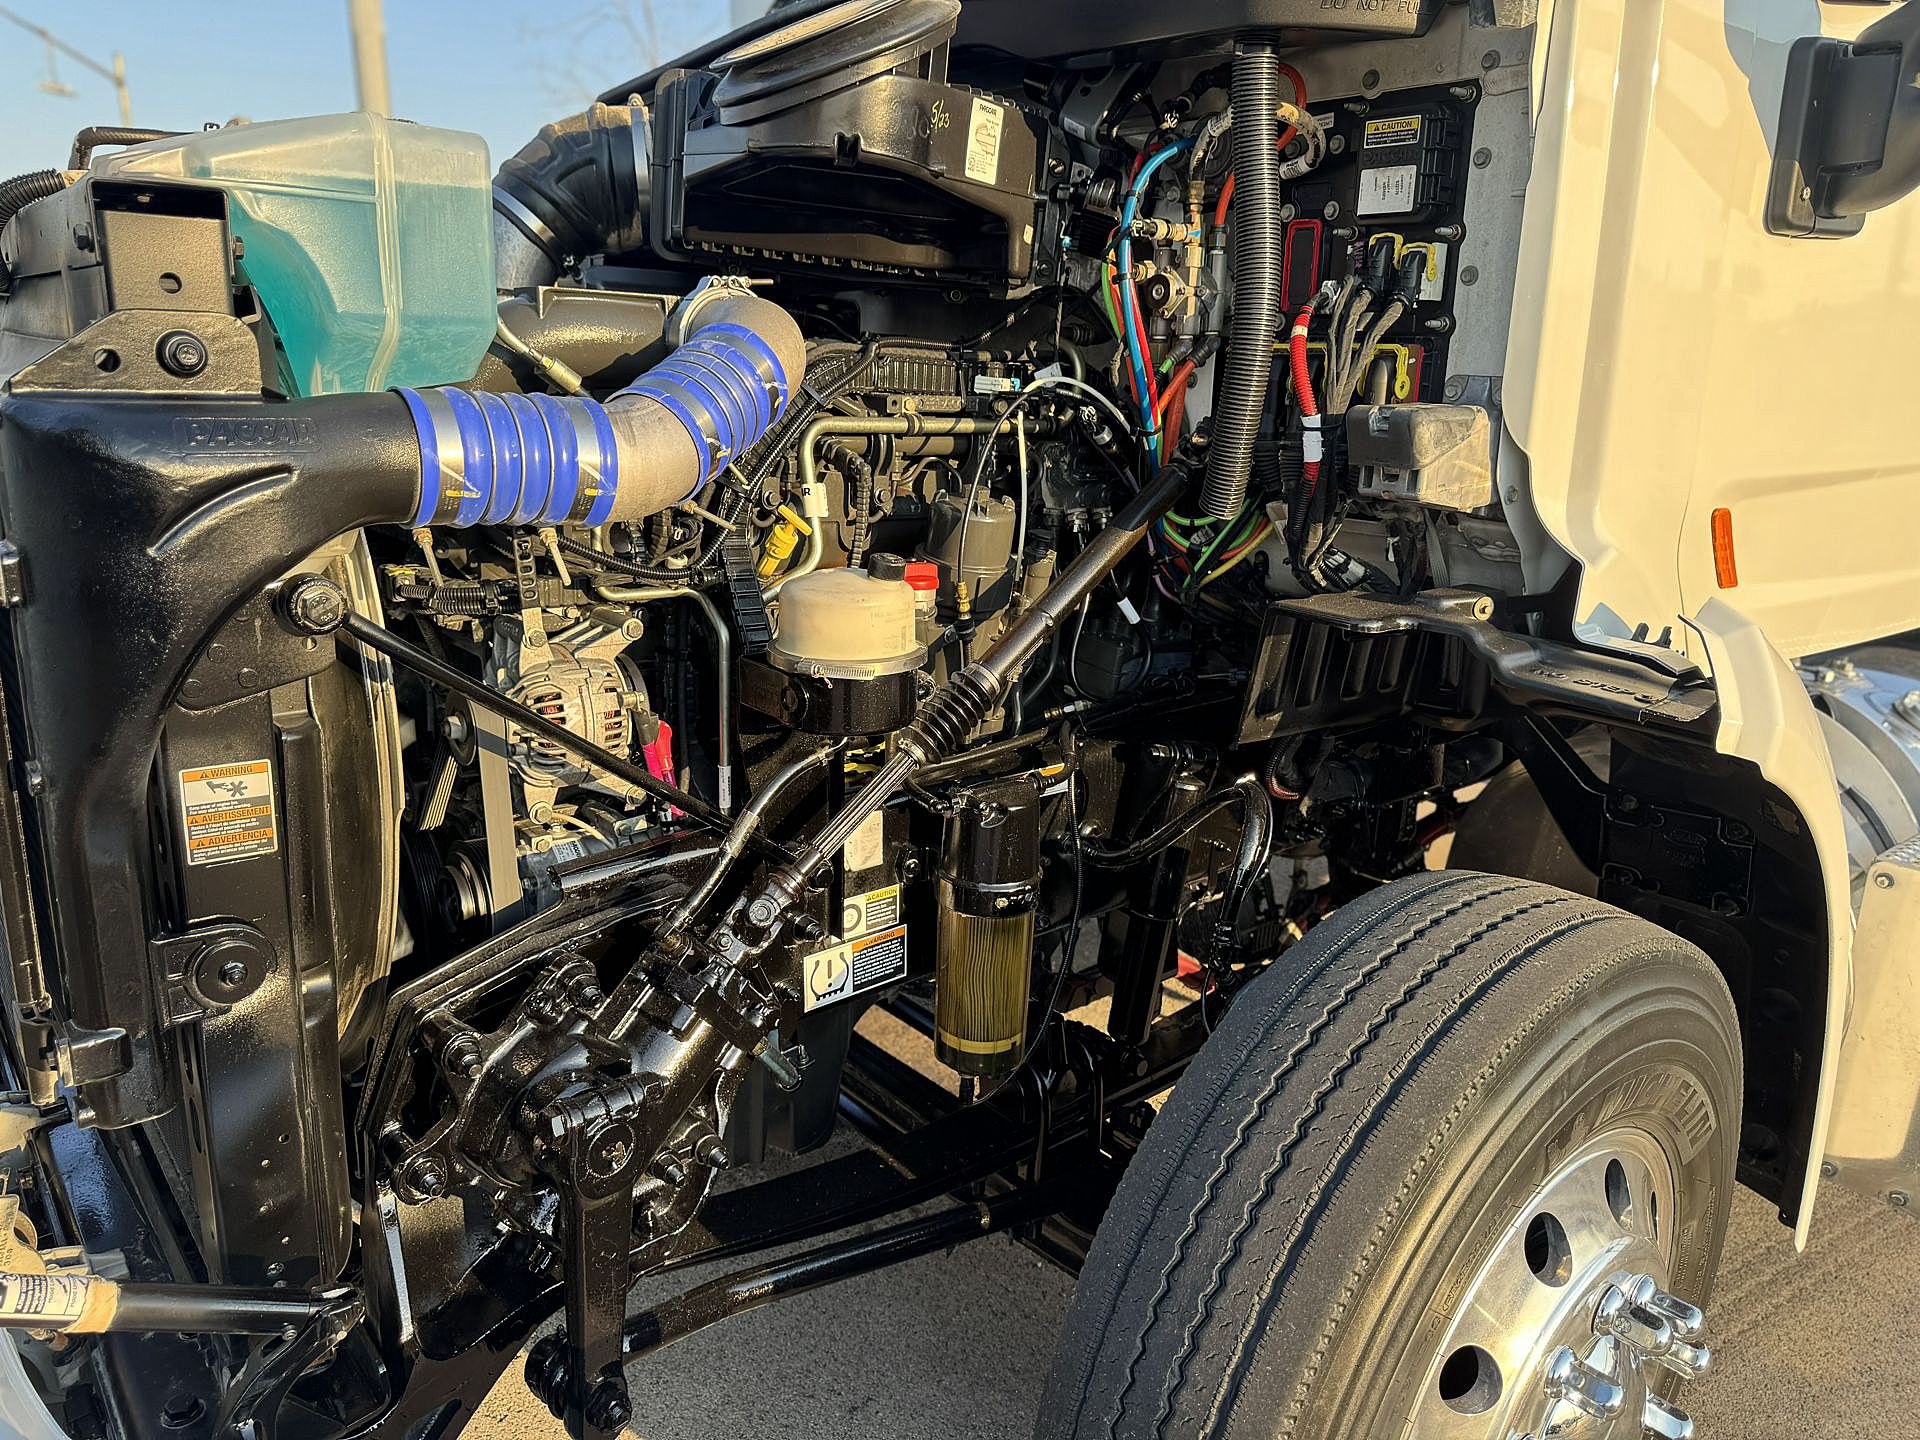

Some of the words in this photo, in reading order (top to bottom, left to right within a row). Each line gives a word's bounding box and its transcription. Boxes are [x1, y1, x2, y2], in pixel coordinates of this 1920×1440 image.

[1381, 121, 1413, 131] CAUTION
[211, 765, 253, 779] WARNING
[202, 806, 269, 823] AVERTISSEMENT
[208, 829, 268, 845] ADVERTENCIA
[872, 889, 897, 900] CAUTION
[1602, 1071, 1713, 1151] MICHELIN
